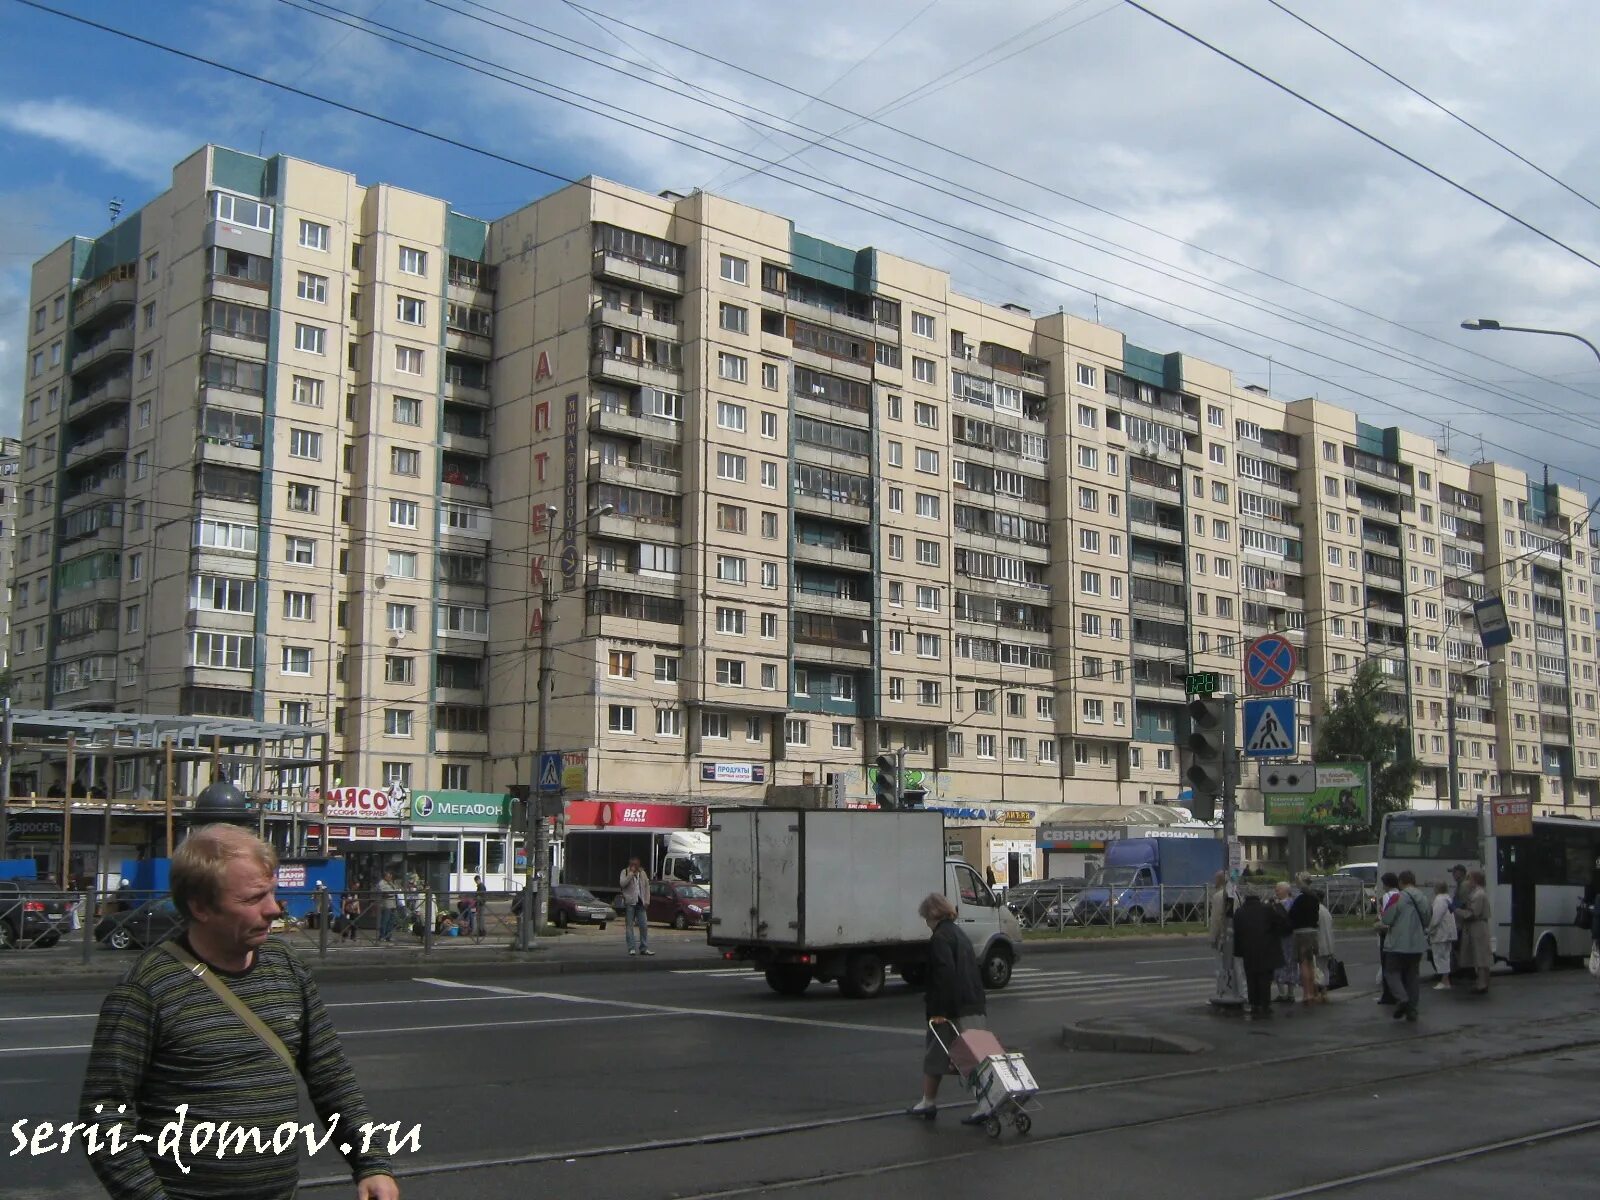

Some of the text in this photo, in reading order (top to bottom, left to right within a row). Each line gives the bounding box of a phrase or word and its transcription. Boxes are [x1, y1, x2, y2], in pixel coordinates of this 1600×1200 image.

[567, 400, 577, 449] ЯШМА
[530, 350, 552, 636] АПТЕКА
[717, 766, 750, 774] ПРОДУКТЫ
[327, 787, 388, 811] МЯСО
[328, 808, 387, 817] УССКИЙ ФЕРМЕР
[624, 808, 647, 818] ВЕСТ
